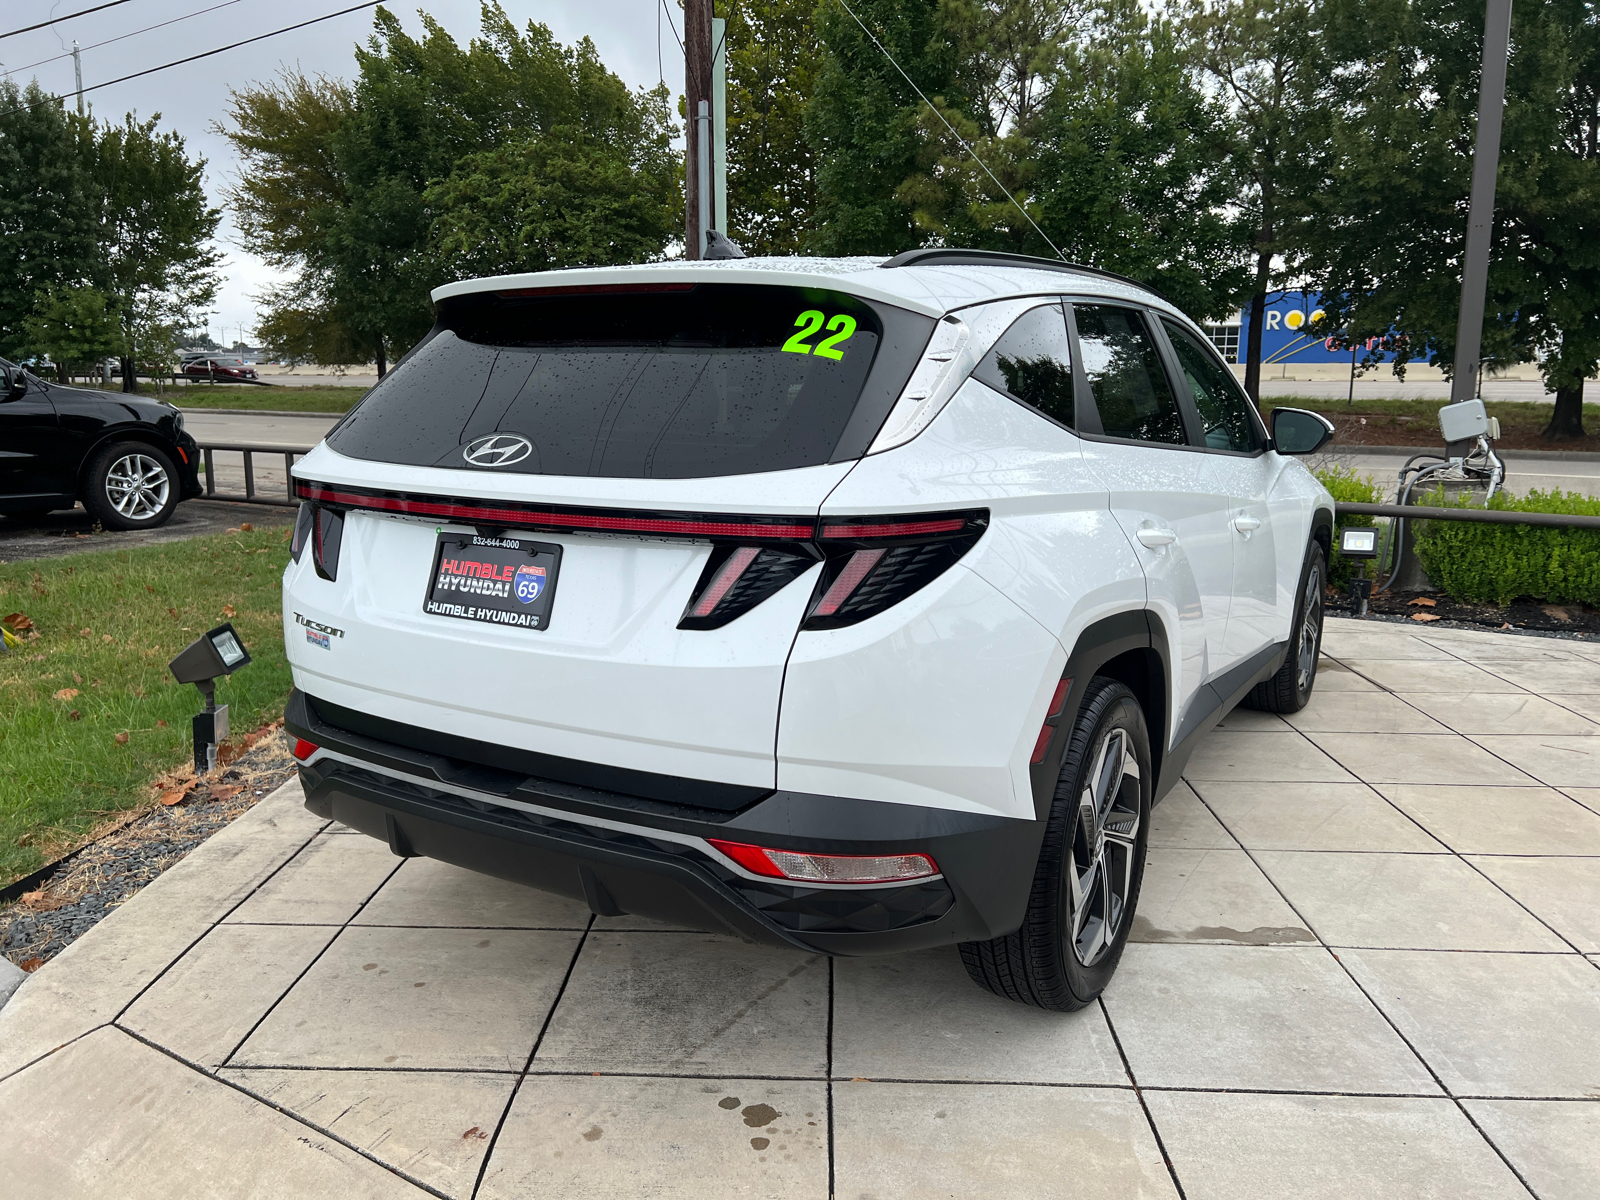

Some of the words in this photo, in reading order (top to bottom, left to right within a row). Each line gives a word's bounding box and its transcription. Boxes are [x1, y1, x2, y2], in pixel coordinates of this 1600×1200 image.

[781, 309, 857, 361] 22
[472, 536, 520, 549] 832-644-4000
[441, 558, 515, 581] HUMBLE
[437, 574, 511, 598] HYUNDAI
[517, 581, 539, 599] 69
[427, 601, 476, 618] HUMBLE
[476, 608, 531, 627] HYUNDAI
